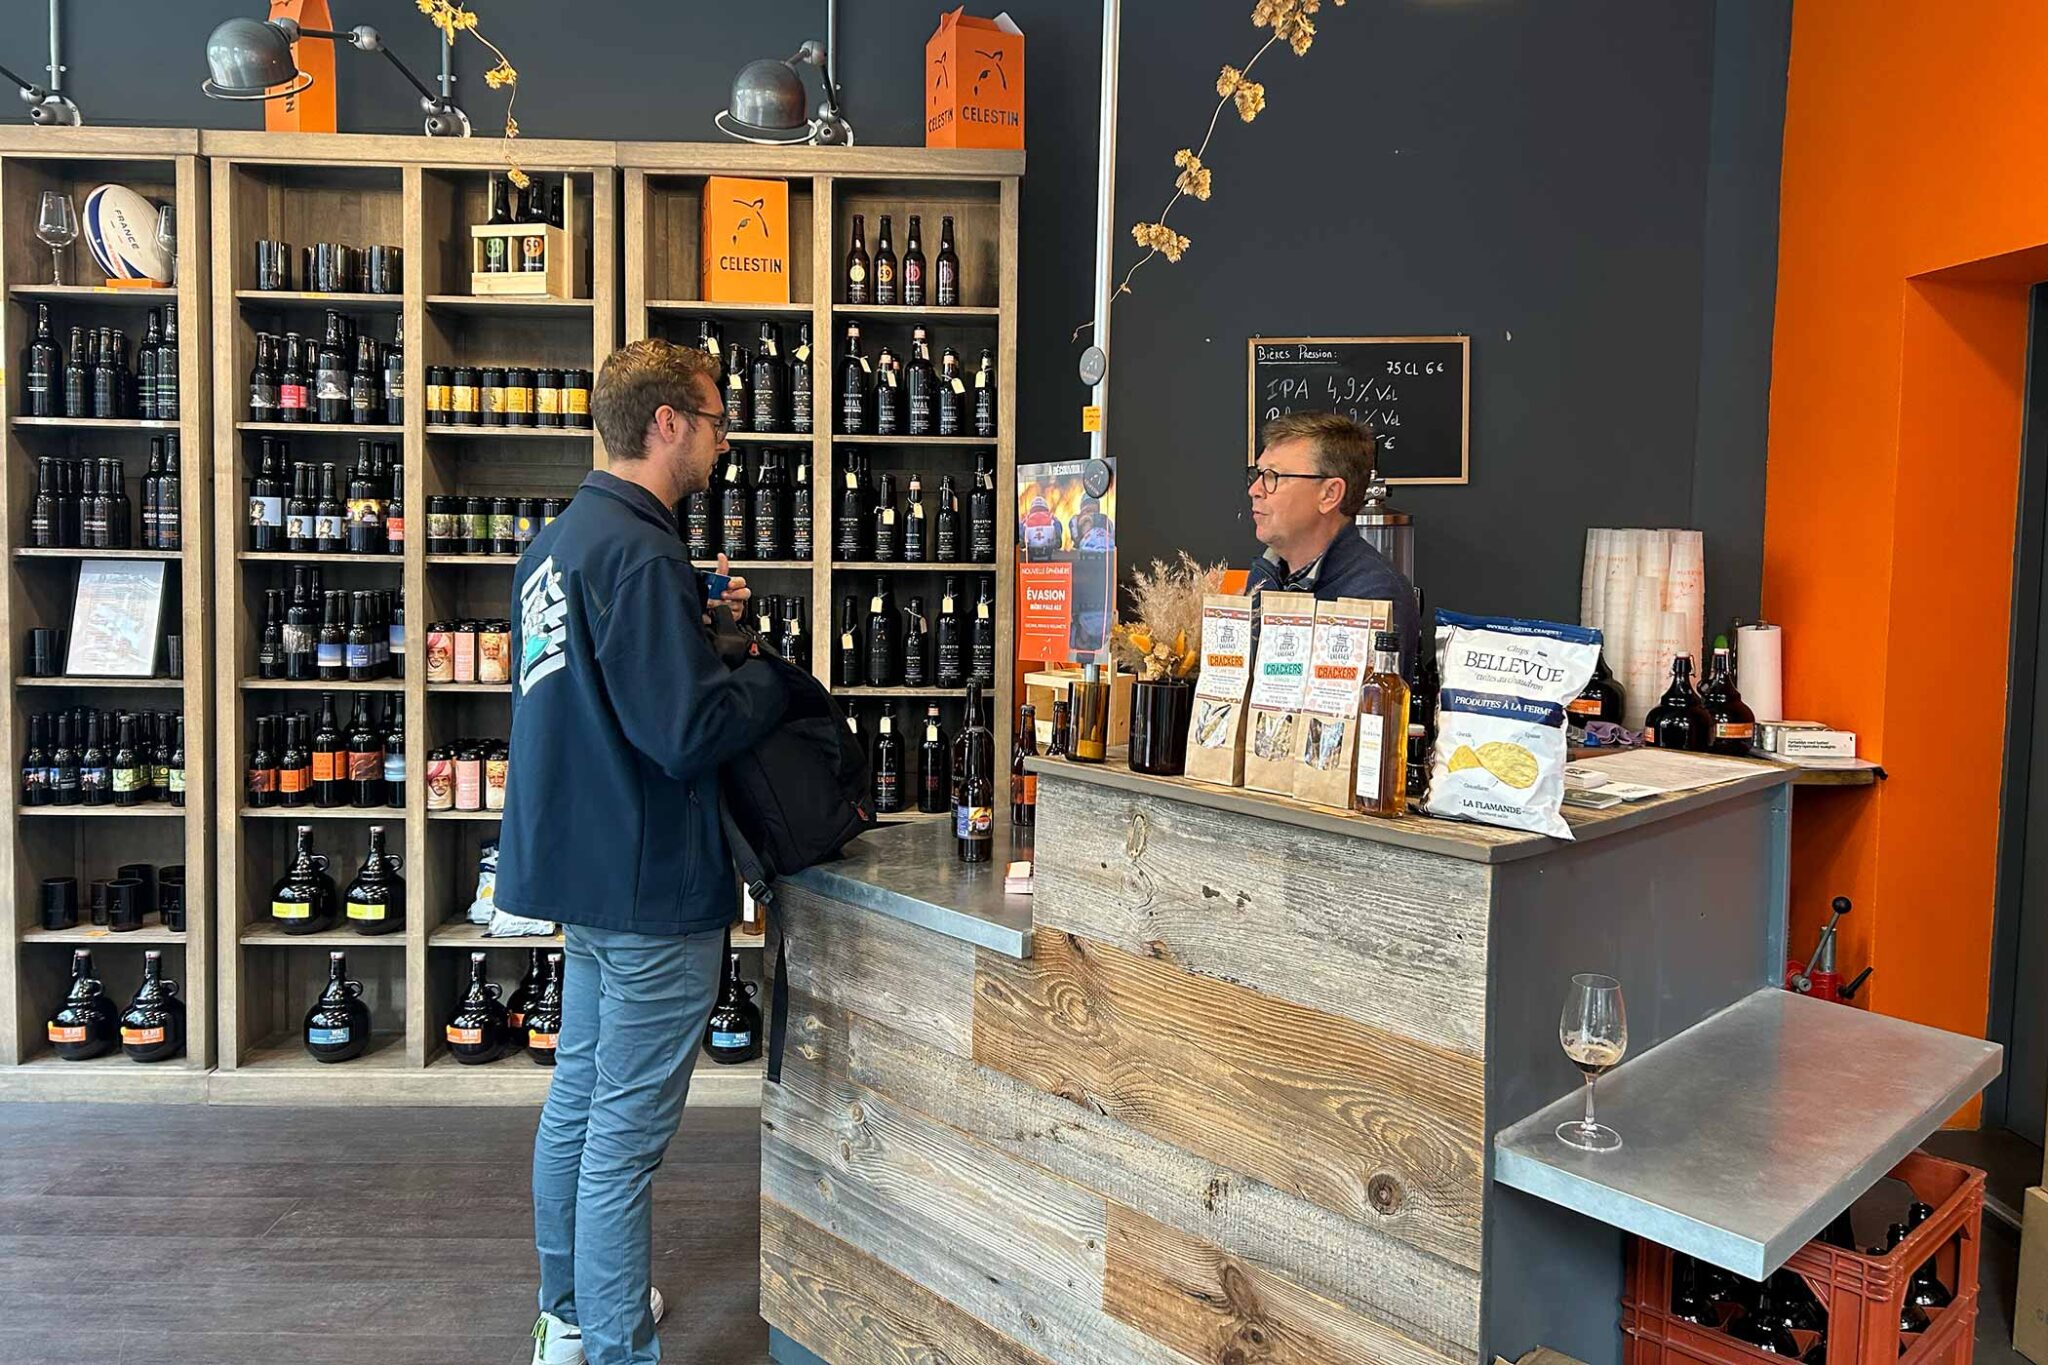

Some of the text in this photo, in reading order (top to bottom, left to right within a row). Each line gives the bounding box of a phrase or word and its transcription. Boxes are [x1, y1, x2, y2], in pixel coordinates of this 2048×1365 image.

[928, 107, 954, 133] CELESTIN
[962, 106, 1019, 127] CELESTIN
[115, 209, 140, 250] FRANCE
[720, 255, 783, 274] CELESTIN
[1257, 345, 1291, 361] Bières
[1266, 377, 1309, 401] IPA
[1026, 587, 1066, 601] ÉVASION
[1210, 655, 1245, 668] CRACKERS
[1266, 663, 1303, 676] CRACKERS
[1464, 650, 1565, 683] BELLEVUE
[1317, 667, 1356, 680] CRACKERS
[1454, 695, 1501, 709] PRODUITES
[1511, 703, 1522, 711] LA
[1463, 799, 1522, 815] LA FLAMANDE
